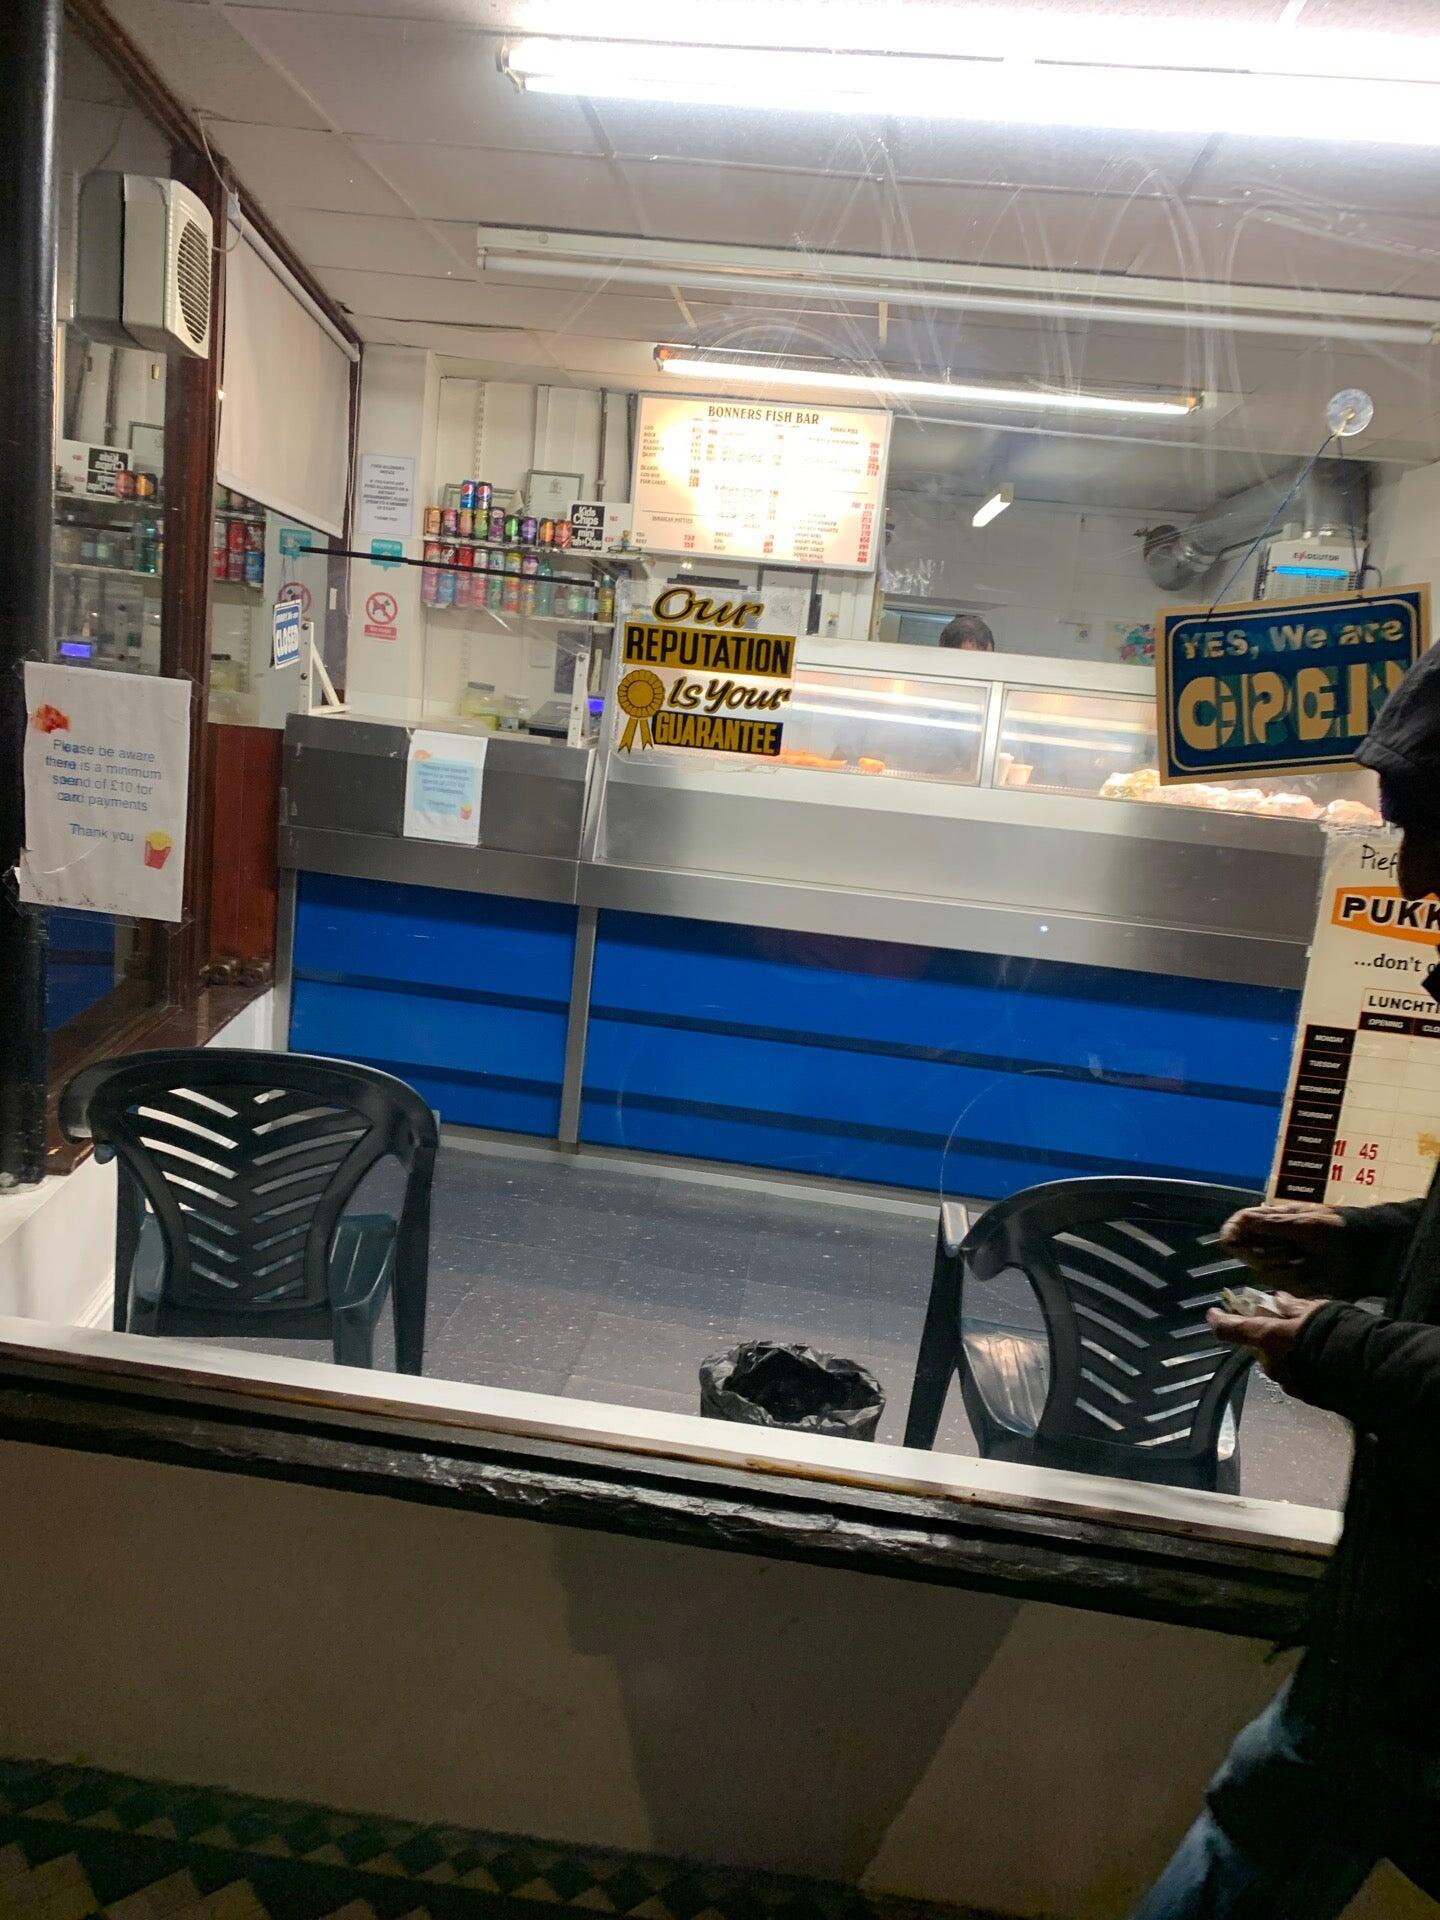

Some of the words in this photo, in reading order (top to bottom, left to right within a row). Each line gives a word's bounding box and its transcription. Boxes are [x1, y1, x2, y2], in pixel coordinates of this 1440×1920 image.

[708, 405, 762, 420] BONNERS
[766, 409, 792, 422] FISH
[796, 412, 819, 424] BAR
[573, 513, 599, 526] Chips
[579, 506, 596, 517] Kids
[653, 587, 765, 628] Our
[1180, 630, 1259, 660] YES,
[1270, 623, 1328, 651] We
[1338, 619, 1404, 646] are
[626, 626, 792, 675] REPUTATION
[667, 676, 703, 709] Is
[703, 678, 792, 714] Your
[654, 712, 778, 754] GUARANTEE
[53, 739, 95, 755] Please
[99, 747, 115, 757] be
[119, 749, 155, 762] aware
[45, 755, 76, 770] there
[80, 760, 91, 772] is
[95, 763, 102, 773] a
[106, 764, 161, 780] minimum
[52, 775, 91, 788] spend
[95, 779, 107, 790] of
[110, 779, 133, 793] £10
[136, 784, 153, 795] for
[57, 791, 84, 803] card
[88, 795, 148, 811] payments
[69, 822, 108, 839] Thank
[112, 831, 134, 842] you
[1368, 1018, 1404, 1029] OPENING
[1314, 1034, 1345, 1043] MONDAY
[1297, 1135, 1322, 1144] FRIDAY
[1359, 1143, 1379, 1160] 45
[1331, 1164, 1344, 1181] 11
[1355, 1168, 1376, 1185] 45
